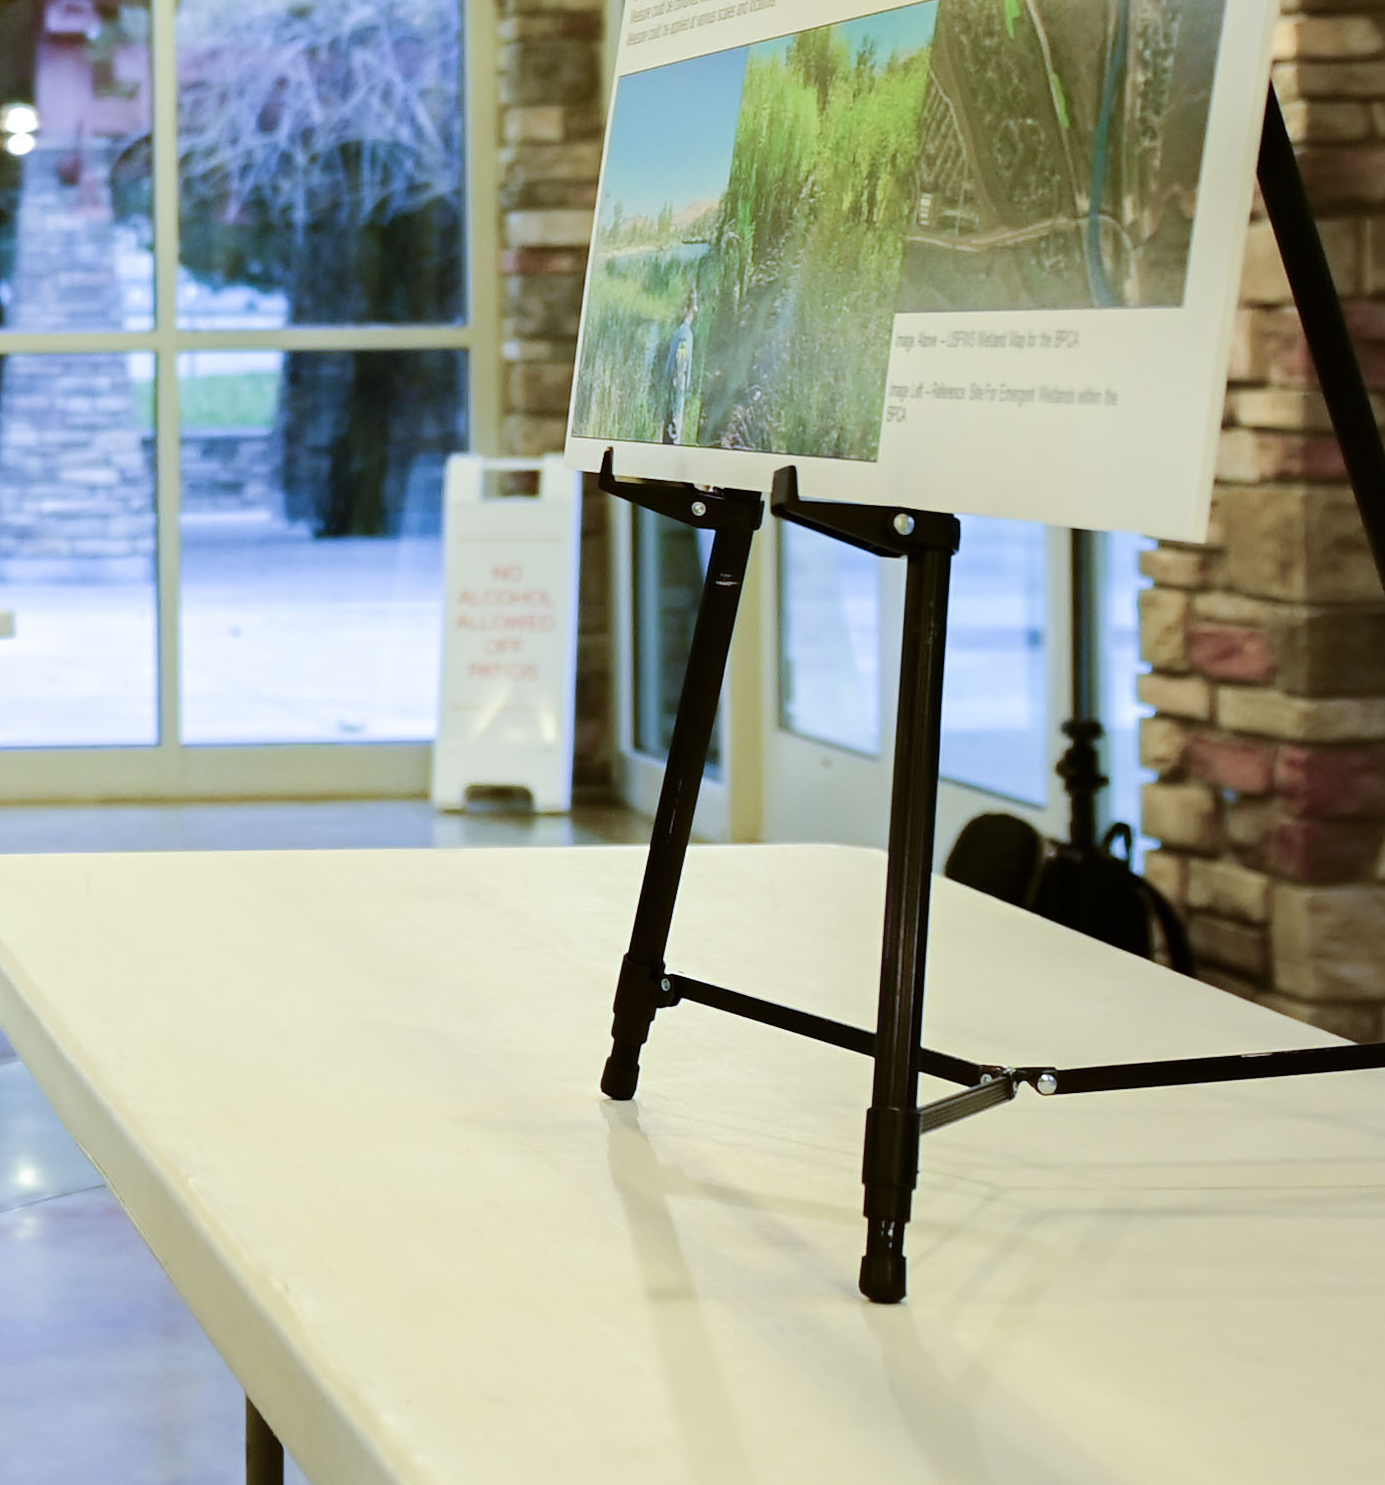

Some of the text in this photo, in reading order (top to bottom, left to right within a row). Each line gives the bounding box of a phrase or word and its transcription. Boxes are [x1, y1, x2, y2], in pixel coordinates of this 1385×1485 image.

[493, 566, 524, 582] NO
[459, 590, 554, 607] ALCOHOL
[458, 615, 556, 632] ALLOWED
